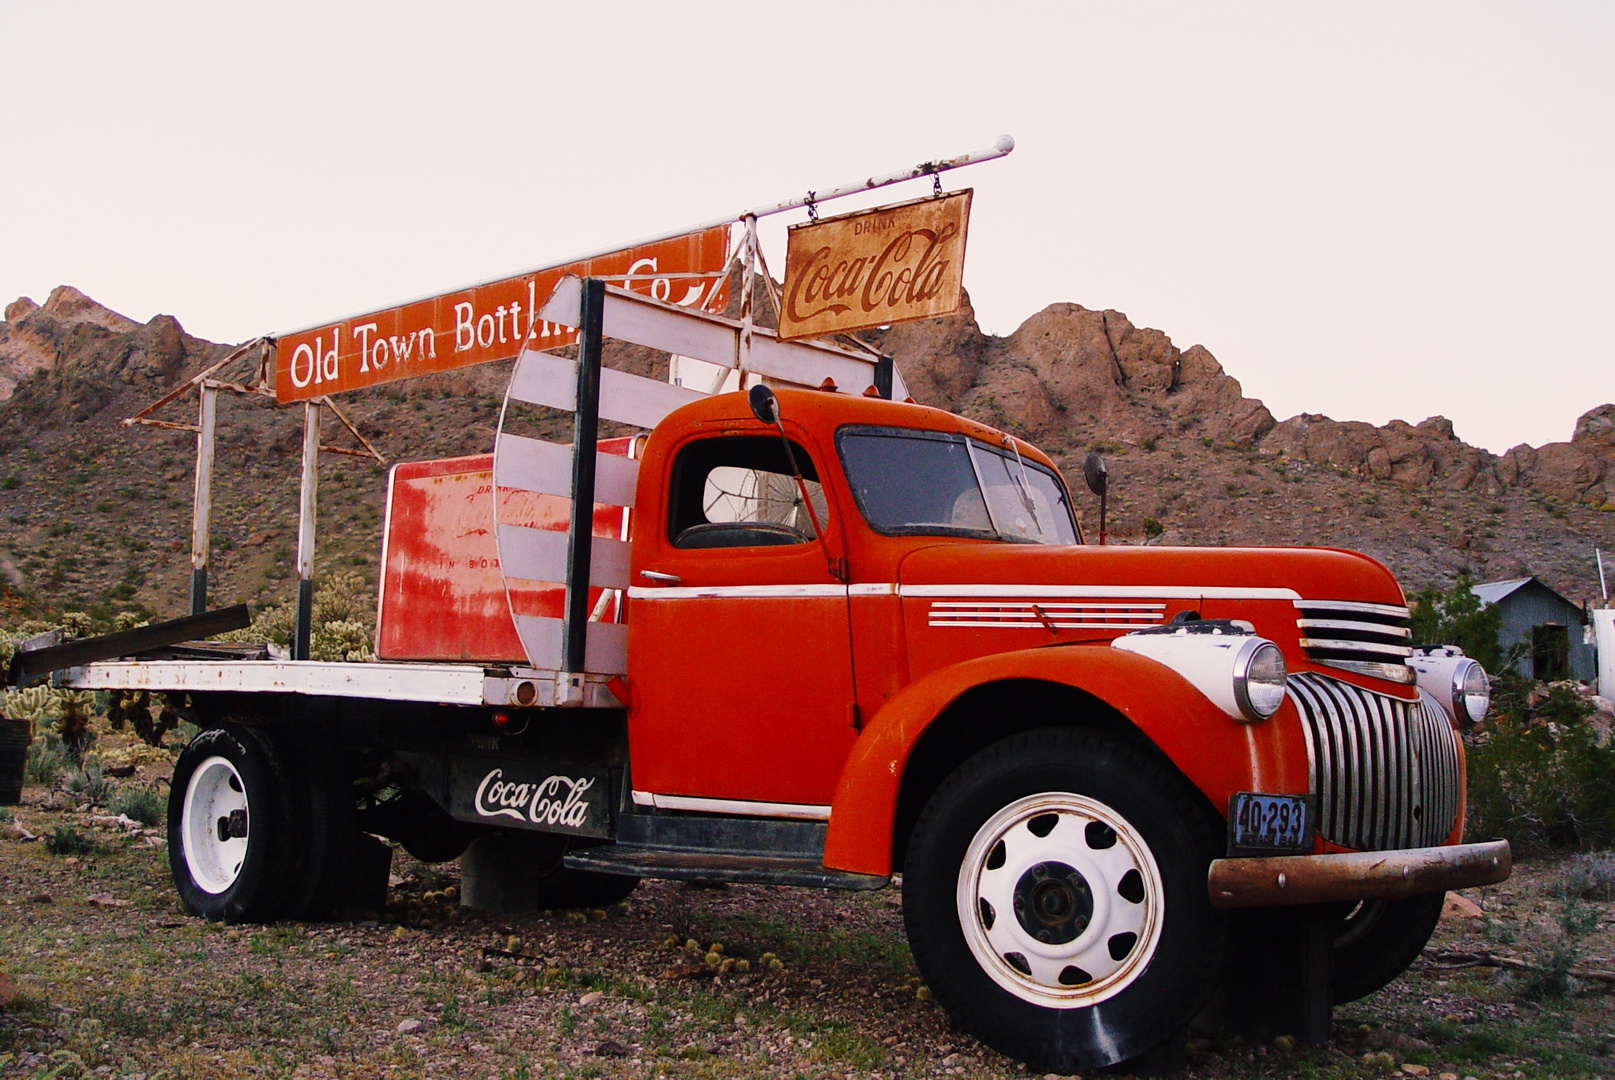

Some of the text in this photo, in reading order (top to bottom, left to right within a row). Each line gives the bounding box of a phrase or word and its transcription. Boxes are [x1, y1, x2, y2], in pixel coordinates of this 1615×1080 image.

[854, 217, 895, 236] DRINK
[787, 222, 959, 323] Coca-Cola
[290, 327, 340, 388] Old
[353, 322, 437, 372] Town
[454, 281, 580, 353] Bottl
[477, 485, 509, 494] DRNK
[475, 768, 596, 828] Coca-Cola
